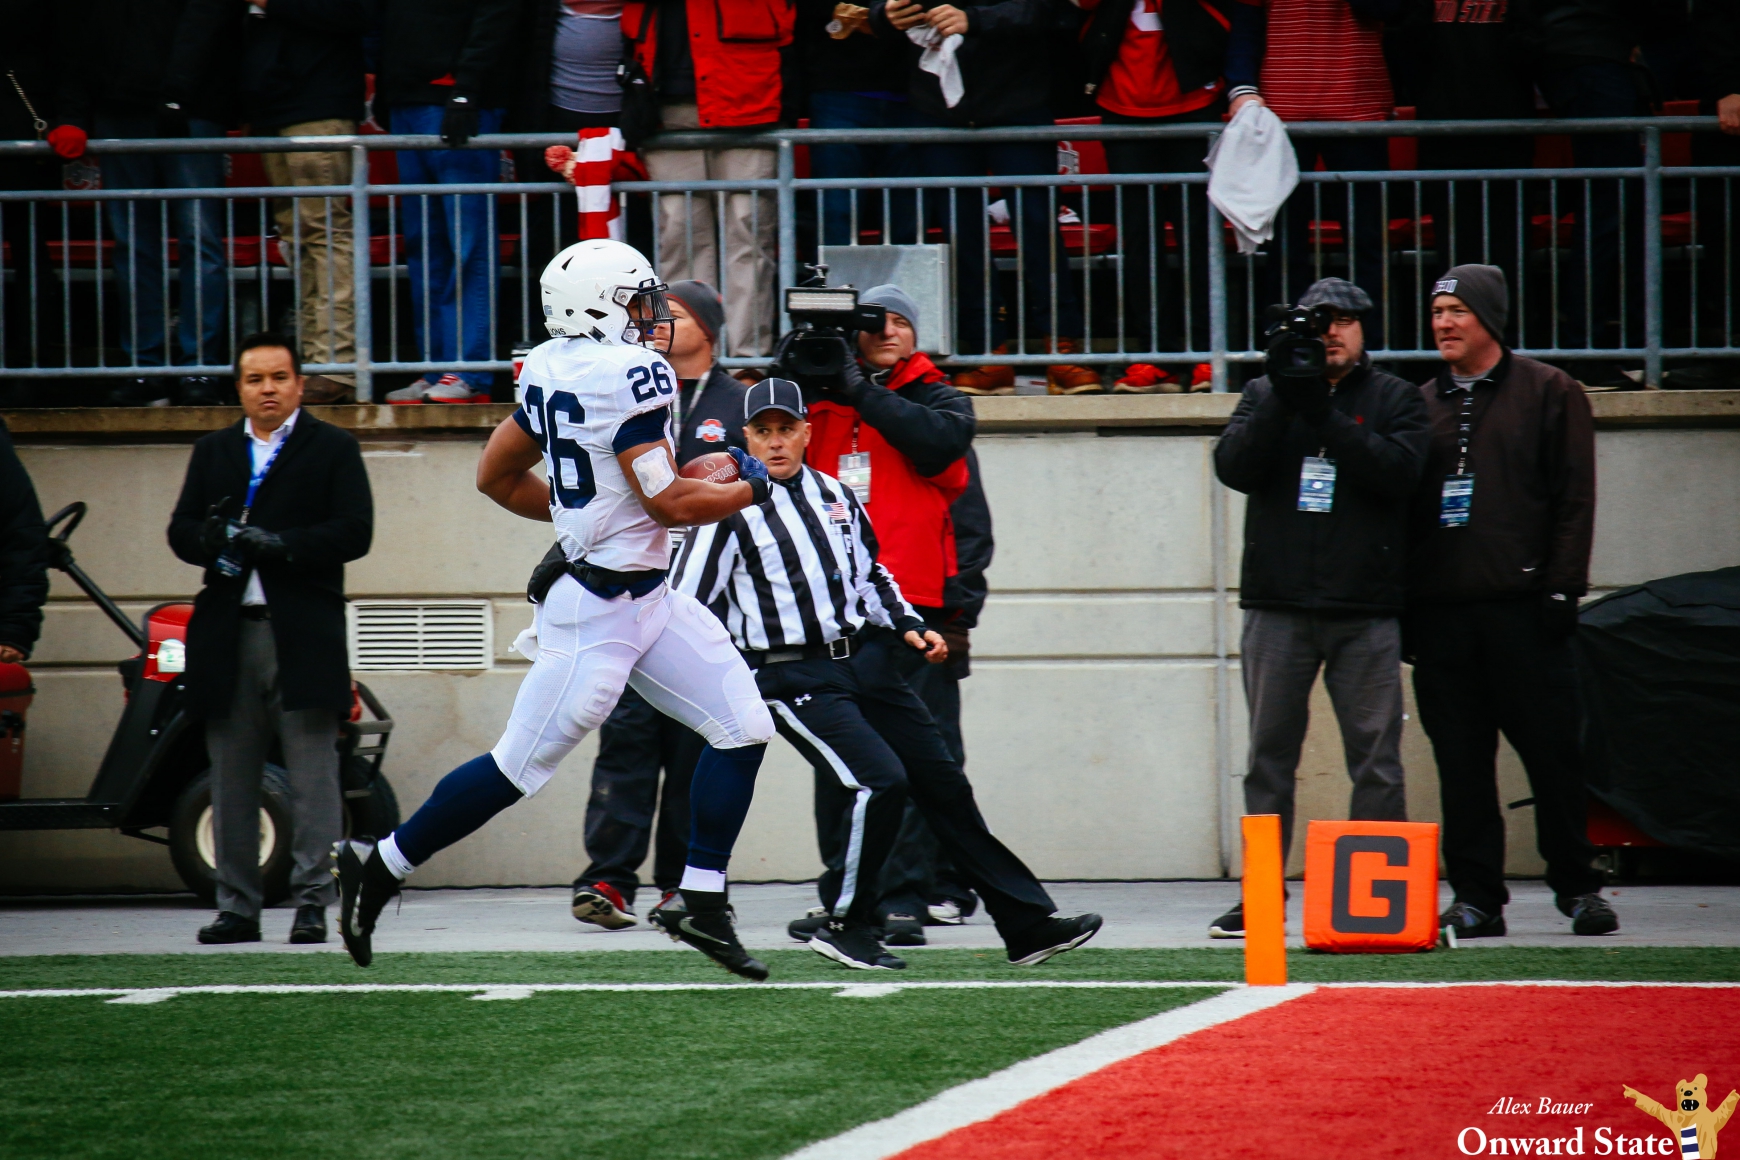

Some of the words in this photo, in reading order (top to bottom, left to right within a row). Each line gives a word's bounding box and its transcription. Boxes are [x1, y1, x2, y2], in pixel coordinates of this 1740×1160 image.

[626, 361, 673, 404] 26
[524, 384, 597, 509] 26
[702, 463, 739, 483] Wilso
[1331, 834, 1410, 934] G
